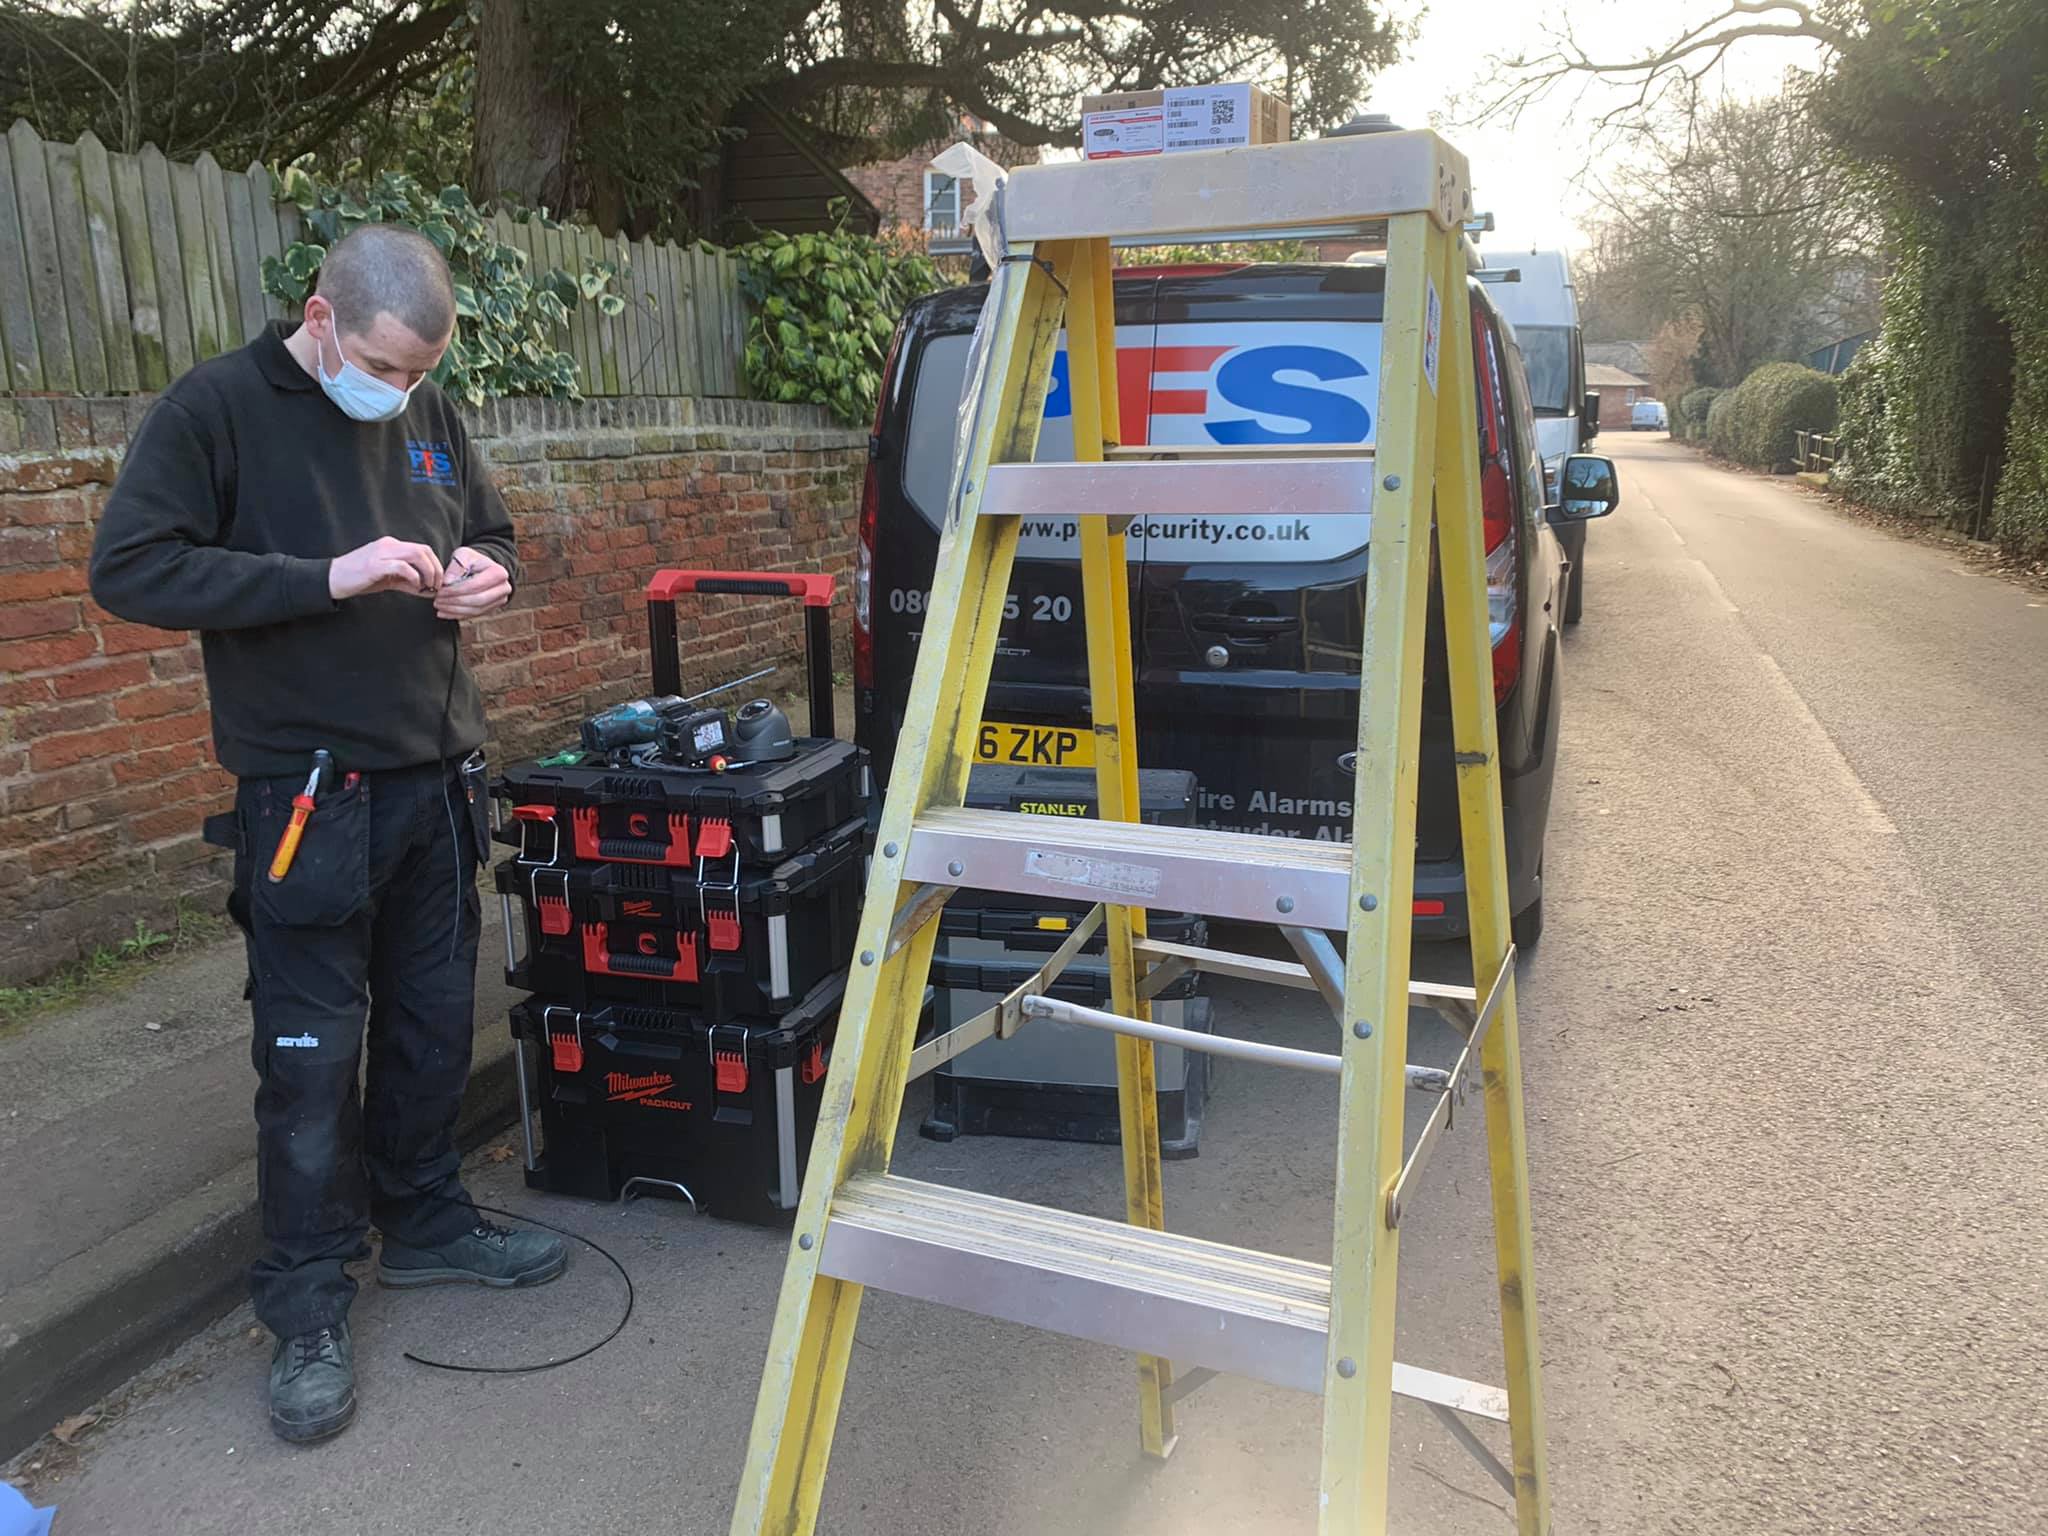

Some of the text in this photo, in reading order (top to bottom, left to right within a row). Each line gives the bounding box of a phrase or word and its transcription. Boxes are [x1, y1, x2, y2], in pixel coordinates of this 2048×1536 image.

[1032, 595, 1072, 621] 20
[1009, 728, 1077, 765] ZKP
[1020, 802, 1087, 816] STANLEY
[1197, 786, 1353, 818] ire Alarms
[640, 1098, 693, 1110] PACKOUT
